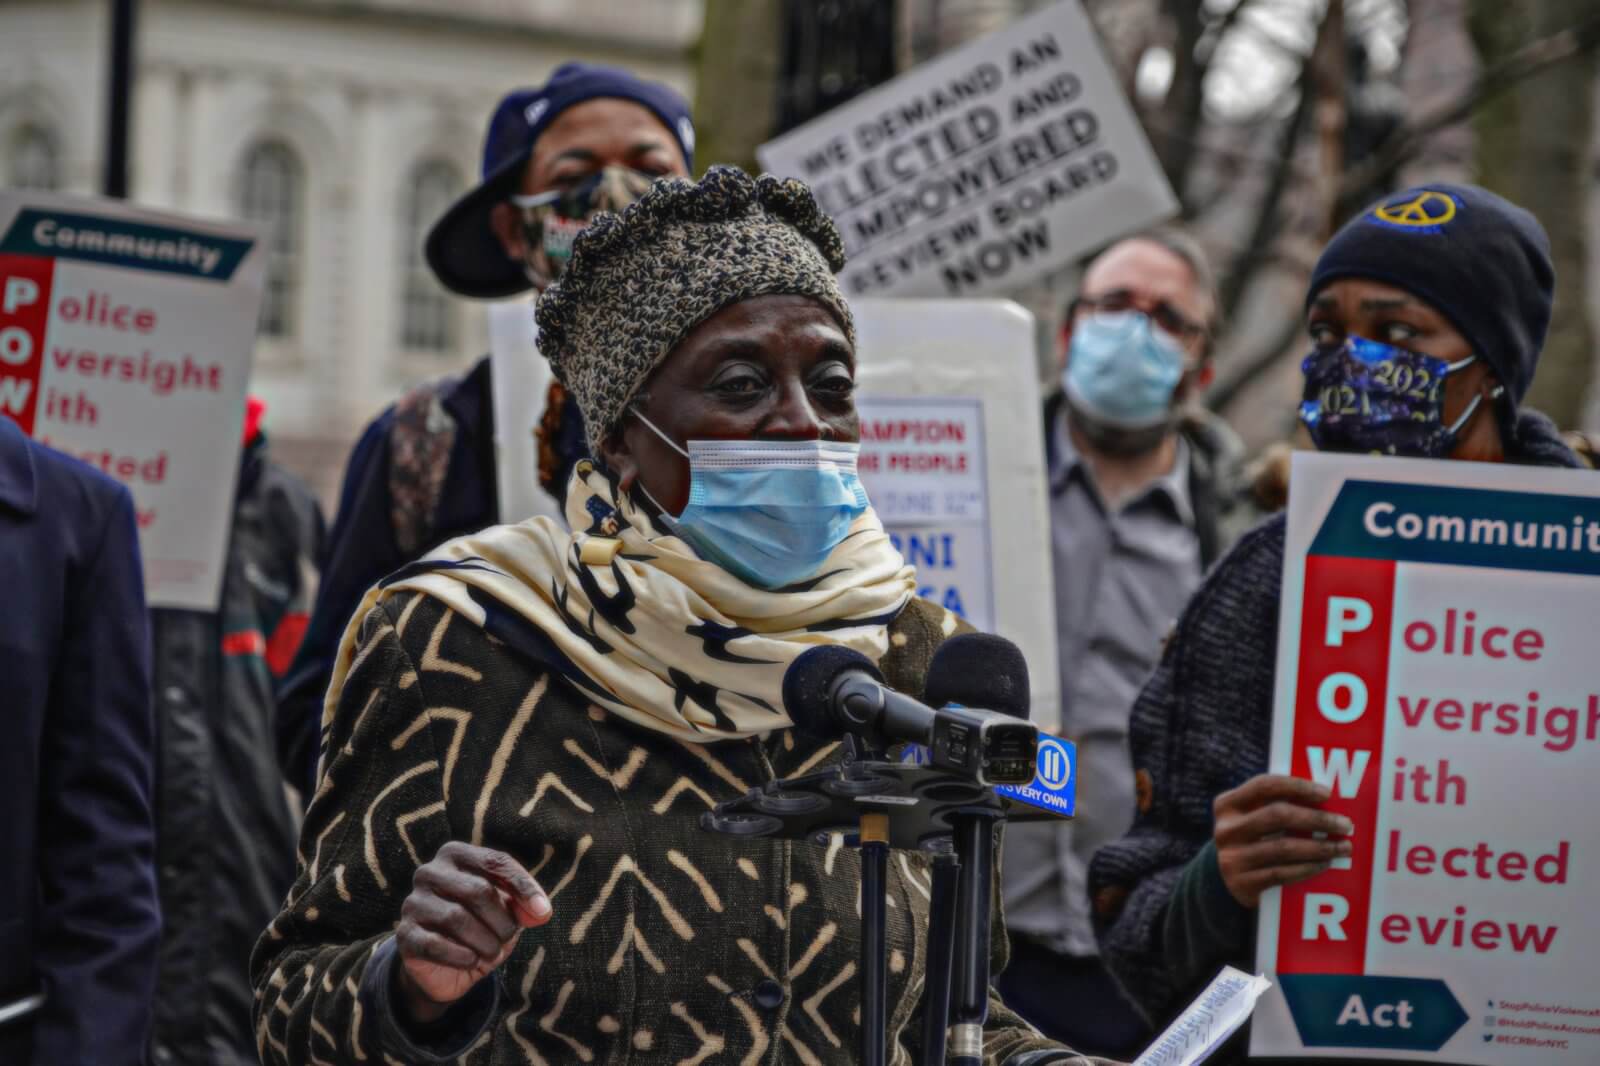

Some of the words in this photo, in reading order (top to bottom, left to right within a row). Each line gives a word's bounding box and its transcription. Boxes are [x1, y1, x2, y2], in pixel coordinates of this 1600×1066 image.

[803, 140, 849, 175] WE
[855, 62, 1001, 152] DEMAND
[1010, 33, 1061, 75] AN
[1012, 72, 1083, 124] AND
[992, 151, 1118, 231] BOARD
[33, 219, 222, 271] Community
[942, 221, 1050, 292] NOW
[1319, 385, 1371, 416] 021
[1363, 501, 1600, 553] Communit
[1015, 785, 1042, 801] VERY
[1042, 793, 1068, 809] OWN
[1336, 994, 1414, 1029] Act
